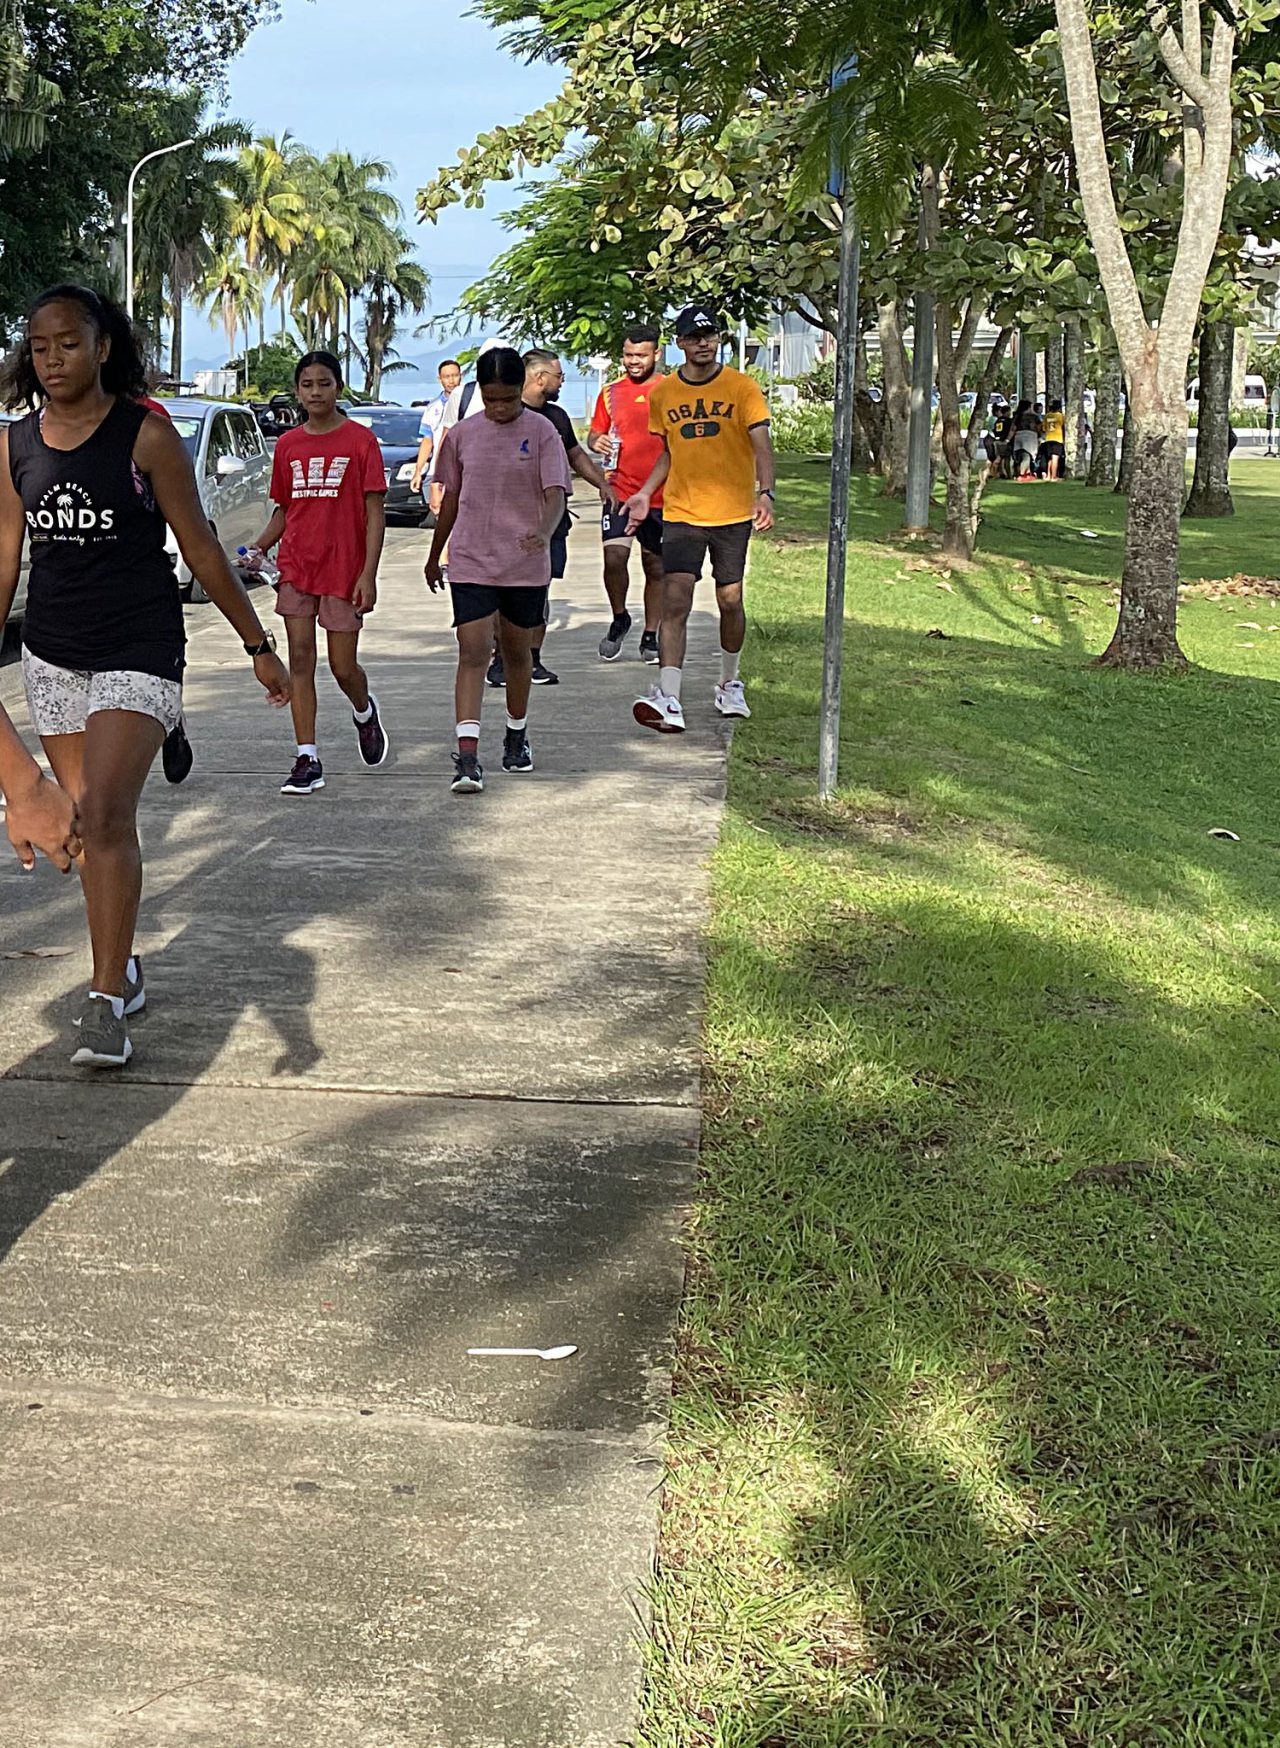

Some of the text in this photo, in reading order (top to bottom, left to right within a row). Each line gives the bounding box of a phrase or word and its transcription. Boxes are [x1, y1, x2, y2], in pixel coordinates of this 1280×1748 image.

[667, 398, 735, 423] OSAKA
[694, 423, 705, 436] 6
[39, 482, 93, 507] PALM BEACH
[25, 509, 114, 530] BONDS
